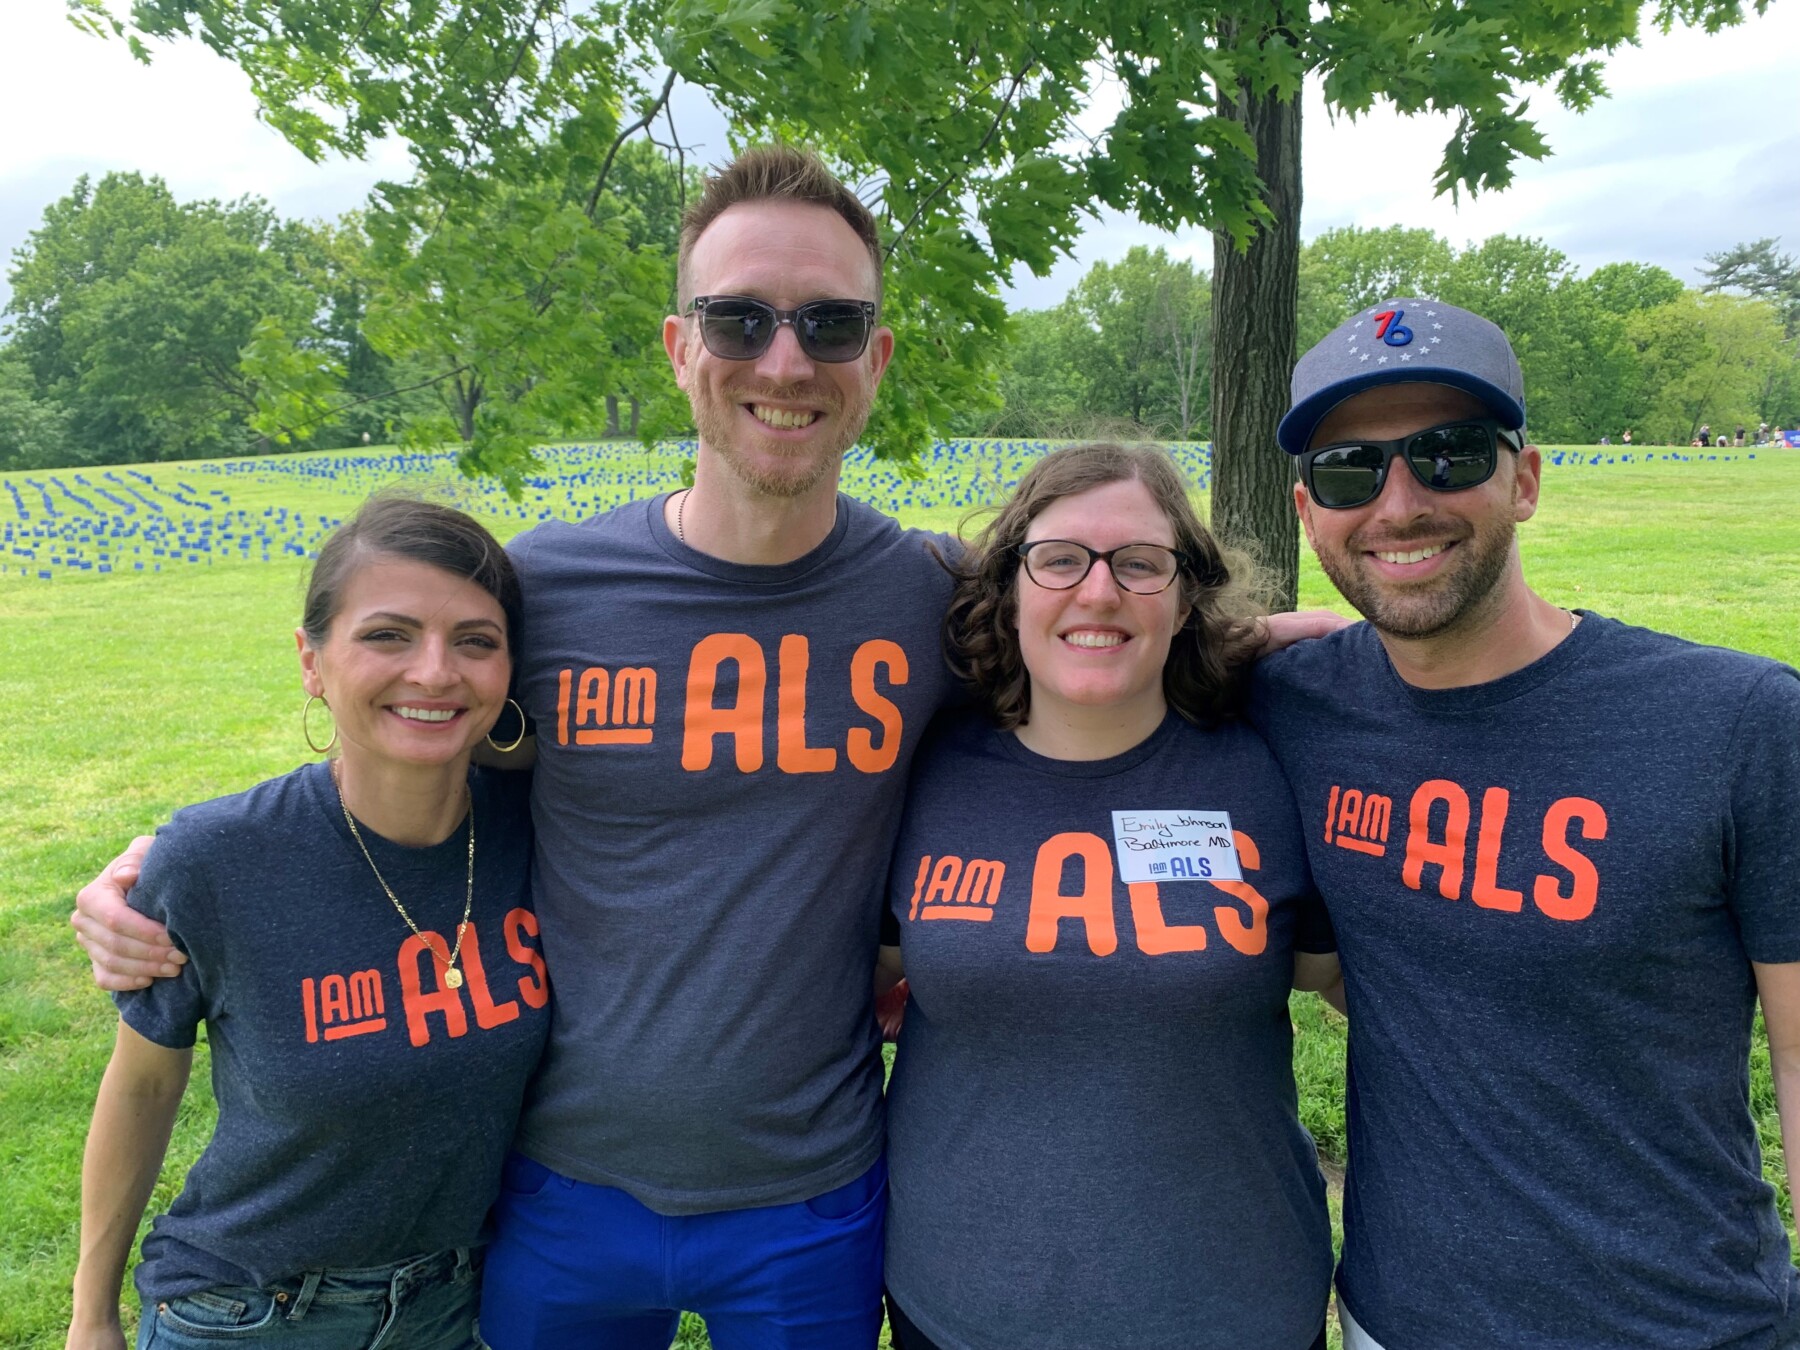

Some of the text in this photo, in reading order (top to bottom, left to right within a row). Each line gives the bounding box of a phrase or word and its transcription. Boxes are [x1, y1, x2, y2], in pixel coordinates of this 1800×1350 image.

[1373, 308, 1413, 346] 76
[557, 632, 909, 773] I AM ALS
[1118, 836, 1232, 851] Baltimore MD
[1121, 814, 1227, 837] Emily Johnson
[1324, 779, 1608, 921] I AM ALS
[908, 829, 1268, 956] I AM ALS
[1153, 861, 1167, 872] AM
[1170, 857, 1212, 877] ALS
[302, 907, 549, 1048] I AM ALS
